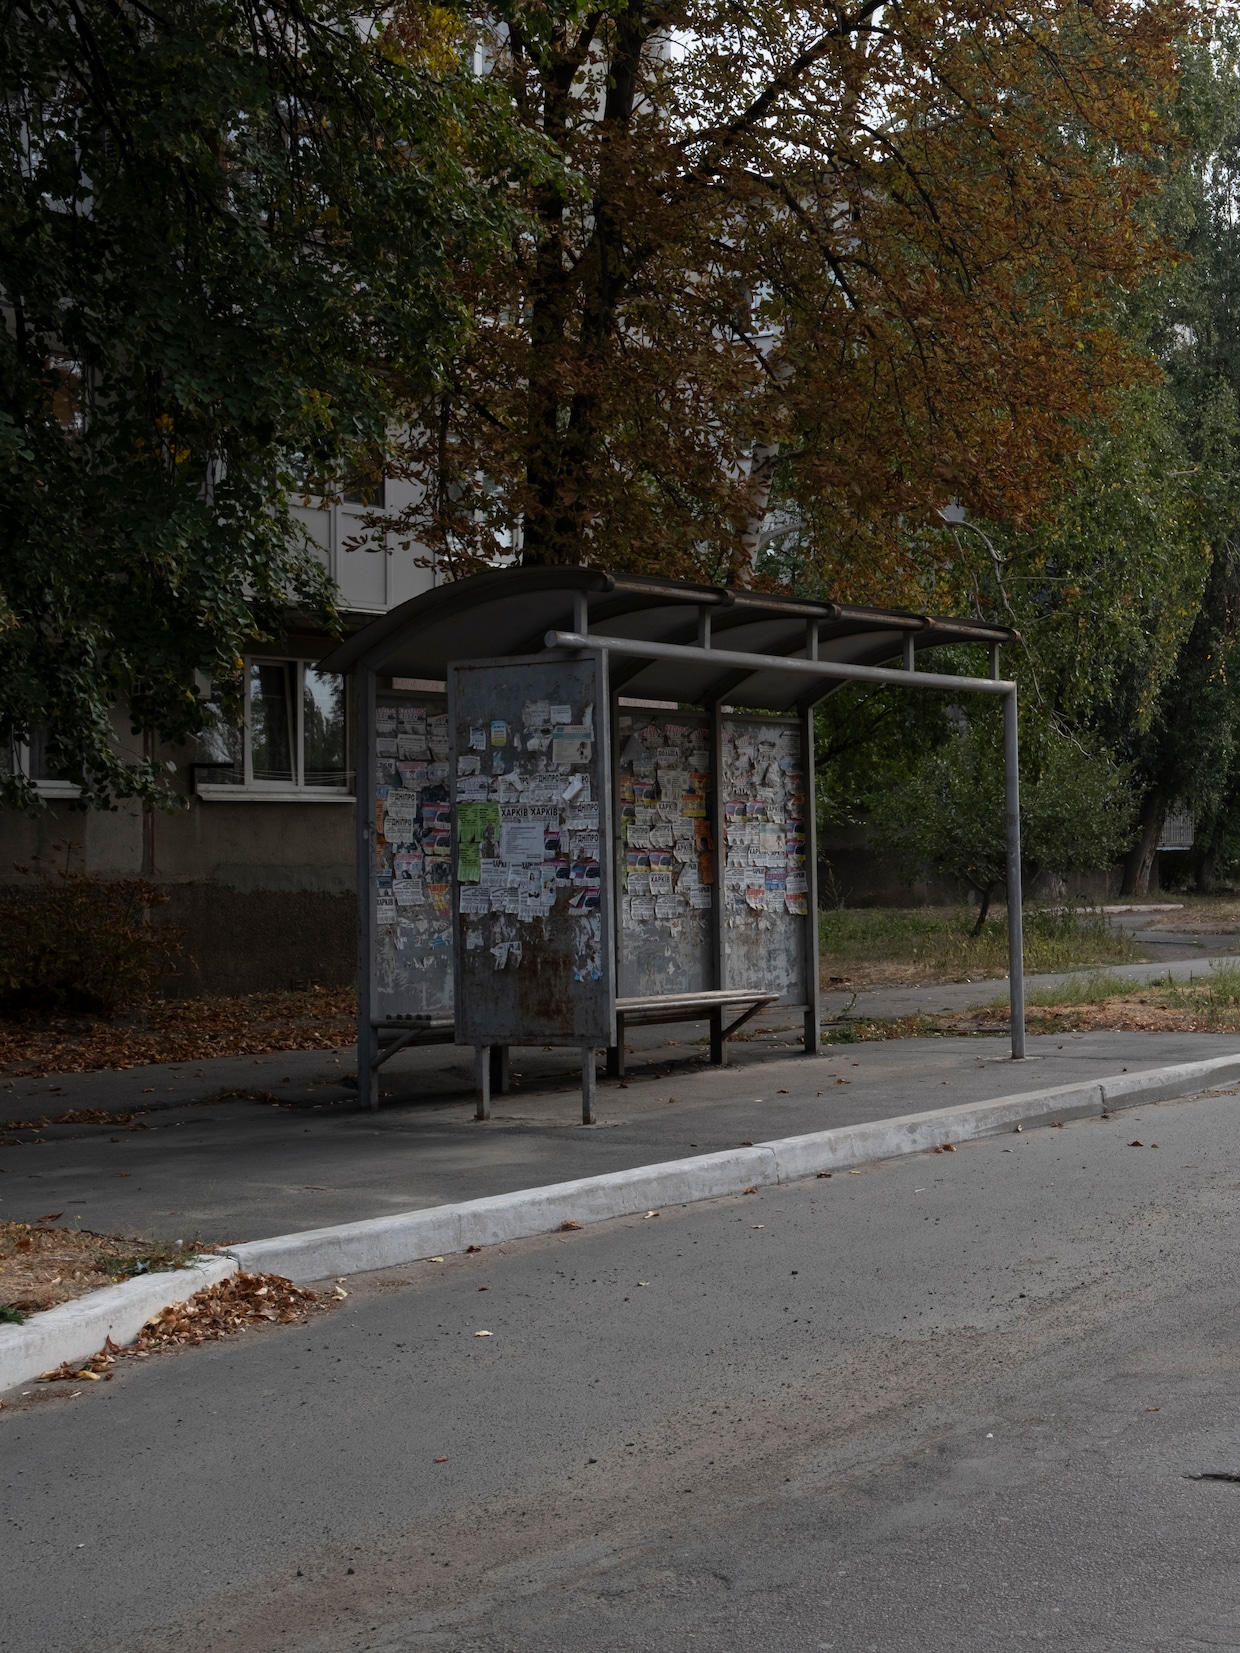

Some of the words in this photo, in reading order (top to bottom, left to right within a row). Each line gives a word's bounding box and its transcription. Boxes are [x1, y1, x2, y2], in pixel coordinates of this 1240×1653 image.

[538, 774, 559, 783] ДНІПРО
[395, 794, 416, 802] ДНІПРО
[501, 807, 529, 817] ХАРКІВ
[530, 807, 558, 817] ХАРКІВ
[577, 804, 598, 812] ДНІПРО
[391, 818, 412, 826] ДНІПРО
[577, 835, 598, 843] ДНІПРО
